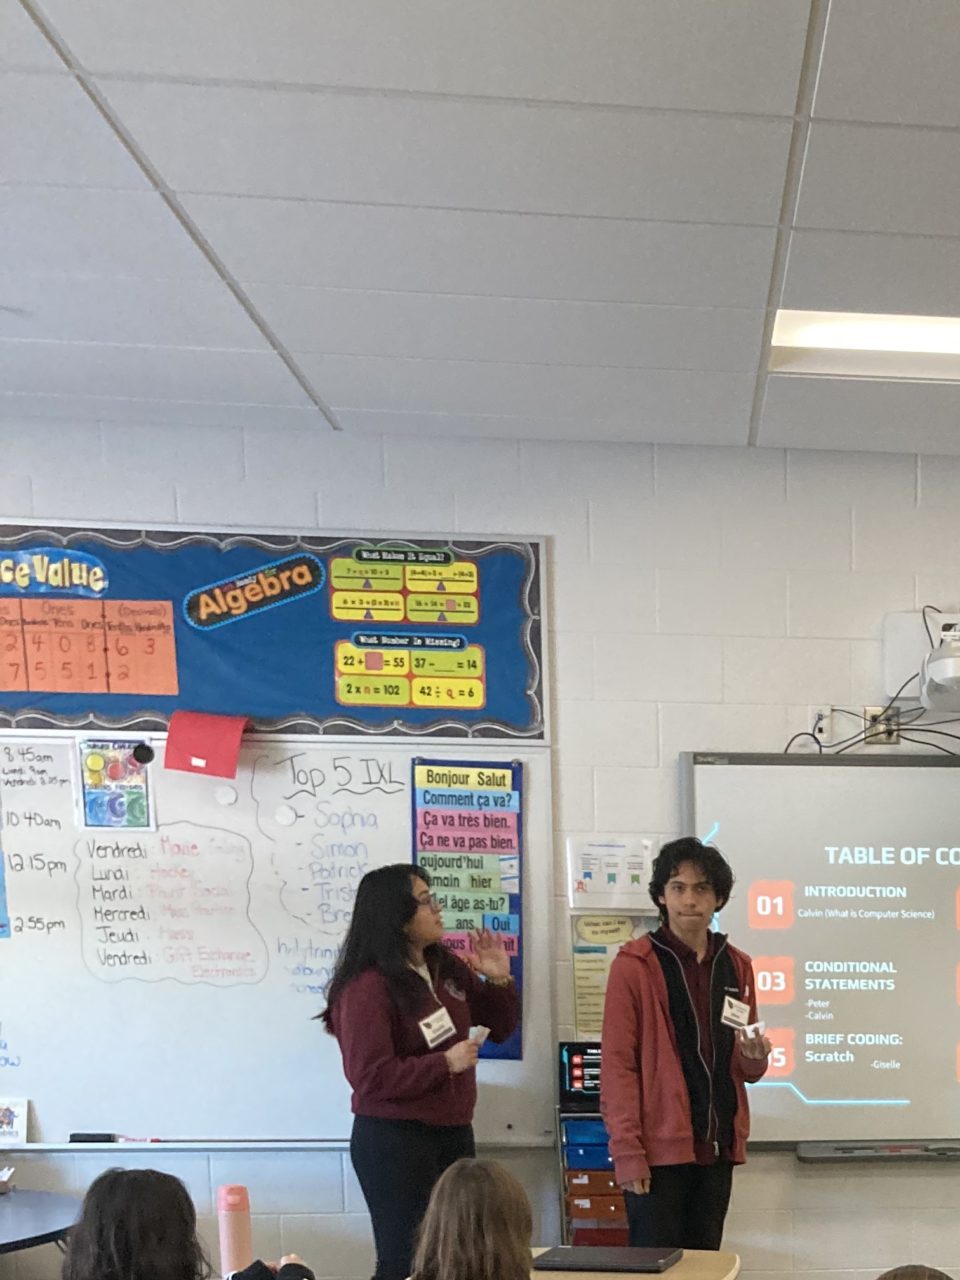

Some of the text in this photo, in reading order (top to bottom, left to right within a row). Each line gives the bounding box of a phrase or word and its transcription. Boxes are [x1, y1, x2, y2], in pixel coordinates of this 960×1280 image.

[32, 554, 105, 592] Value
[199, 564, 313, 620] Algebra
[6, 634, 18, 652] 2
[31, 634, 43, 652] 4
[59, 635, 72, 653] 0
[115, 638, 129, 656] 6
[143, 638, 156, 656] 3
[343, 655, 405, 668] 22 55
[414, 657, 478, 670] 37 14
[8, 661, 131, 681] 7 5 5 1 2
[346, 683, 353, 694] 2
[383, 684, 400, 695] 102
[419, 685, 475, 698] 42 6
[276, 753, 406, 795] Top 5 IXL
[427, 769, 507, 788] Bonjour Salut
[423, 789, 513, 811] Comment ça va?
[423, 811, 511, 829] Ça va très bien.
[87, 840, 149, 859] Vendredi
[420, 832, 516, 851] Ça ne va pas bien.
[420, 855, 484, 872] aujourd'hui
[824, 846, 895, 865] TABLE
[900, 847, 930, 865] OF
[92, 864, 129, 881] Lundi
[470, 874, 493, 889] hier
[92, 885, 133, 901] Mardi
[756, 885, 907, 916] 01 INTRODUCTION
[451, 896, 506, 913] âge as-tu?
[94, 905, 151, 922] Mercredi
[797, 908, 935, 920] Calvin (What is Computer Science)
[455, 916, 511, 931] ans Oui
[96, 926, 140, 944] Jeudi
[97, 949, 152, 967] Vendredi
[757, 961, 897, 991] 03 CONDITIONAL
[804, 978, 896, 990] STATEMENTS
[804, 999, 830, 1008] -Peter
[804, 1011, 834, 1021] -Calvin
[768, 1033, 904, 1067] 5 BRIEF CODING:
[804, 1050, 855, 1062] Scratch
[870, 1060, 901, 1069] -Giselle
